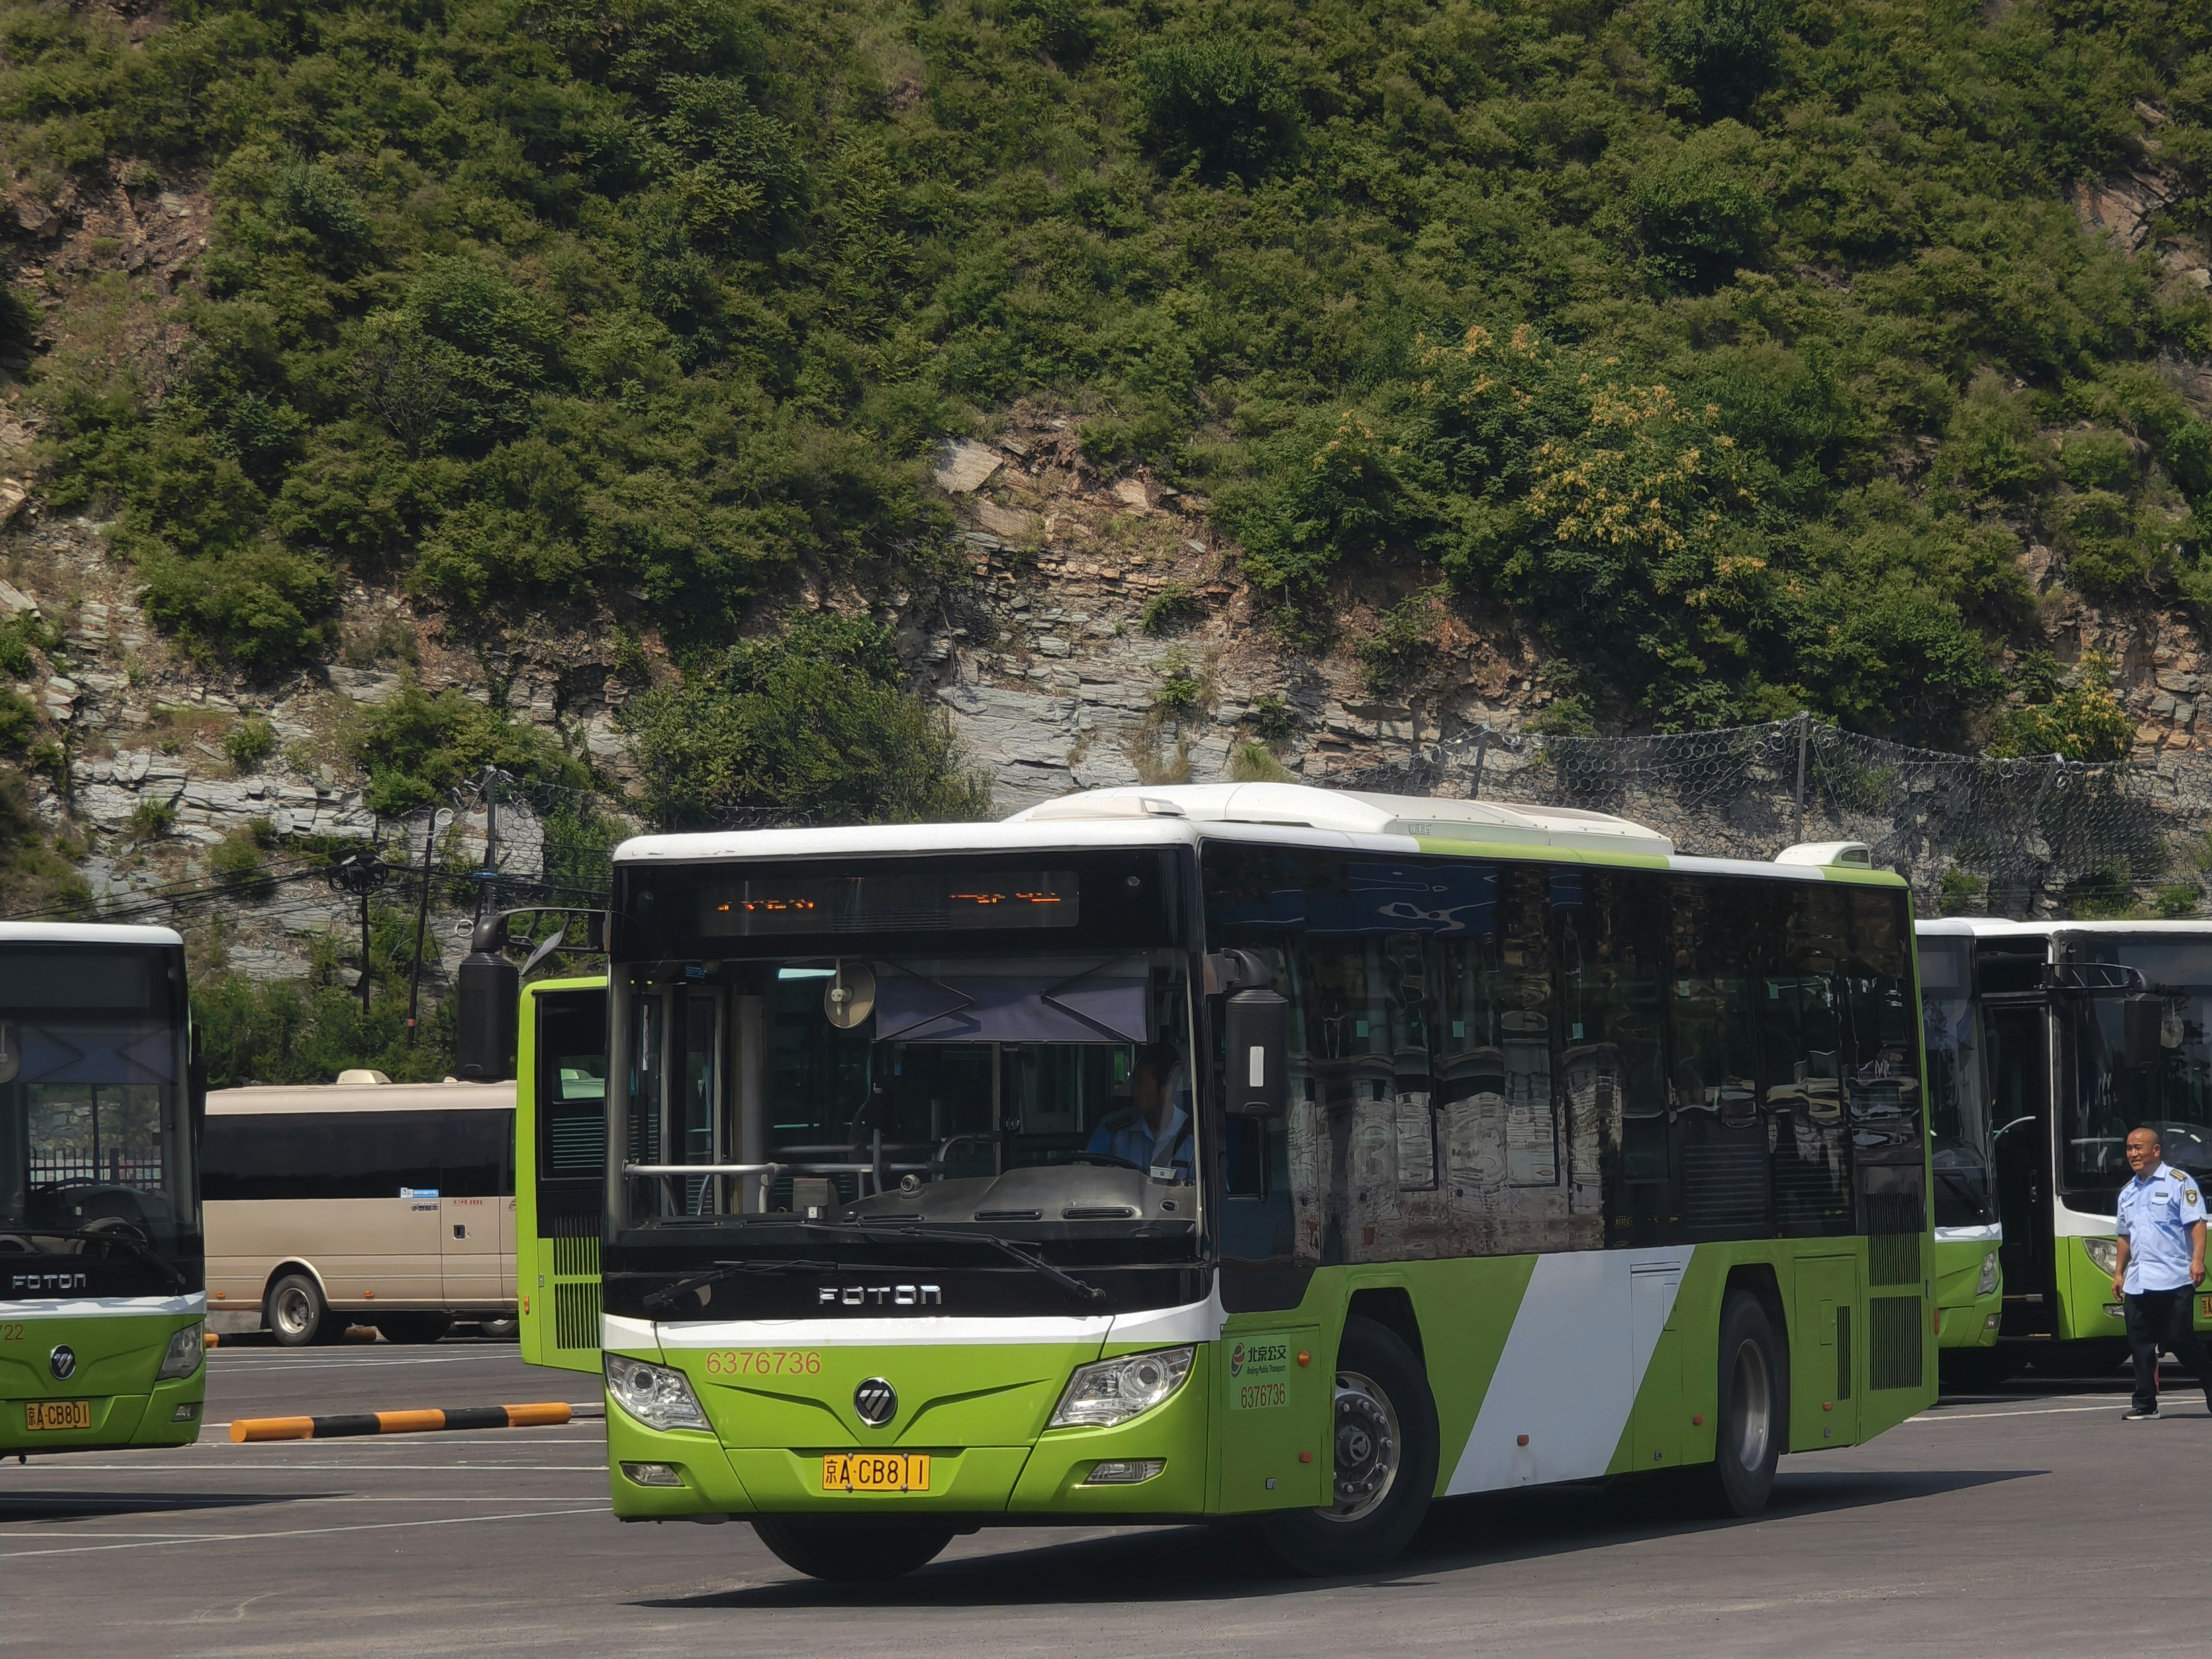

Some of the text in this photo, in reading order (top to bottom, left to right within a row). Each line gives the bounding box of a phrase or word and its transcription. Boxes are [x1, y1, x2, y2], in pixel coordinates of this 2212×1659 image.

[12, 1274, 86, 1289] FOTON
[819, 1285, 942, 1304] FOTON
[707, 1352, 821, 1374] 6376736
[1248, 1345, 1286, 1362] 北京公交
[1241, 1382, 1286, 1408] 6376736
